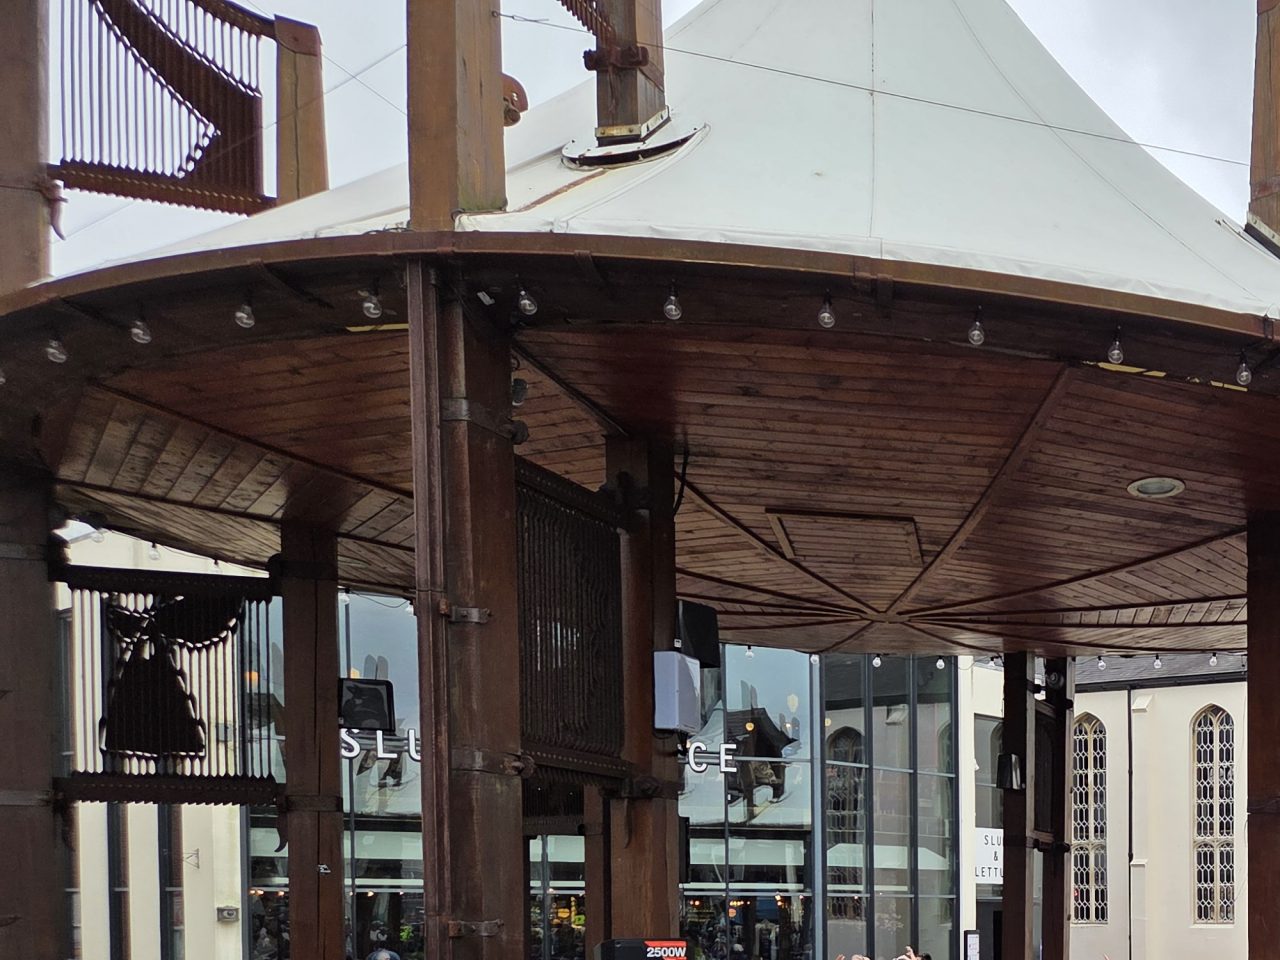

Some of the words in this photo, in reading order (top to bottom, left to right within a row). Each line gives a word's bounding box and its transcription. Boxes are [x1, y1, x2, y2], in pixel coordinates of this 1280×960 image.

[340, 728, 421, 761] SLU
[984, 835, 1001, 846] SLU
[646, 947, 687, 958] 2500W
